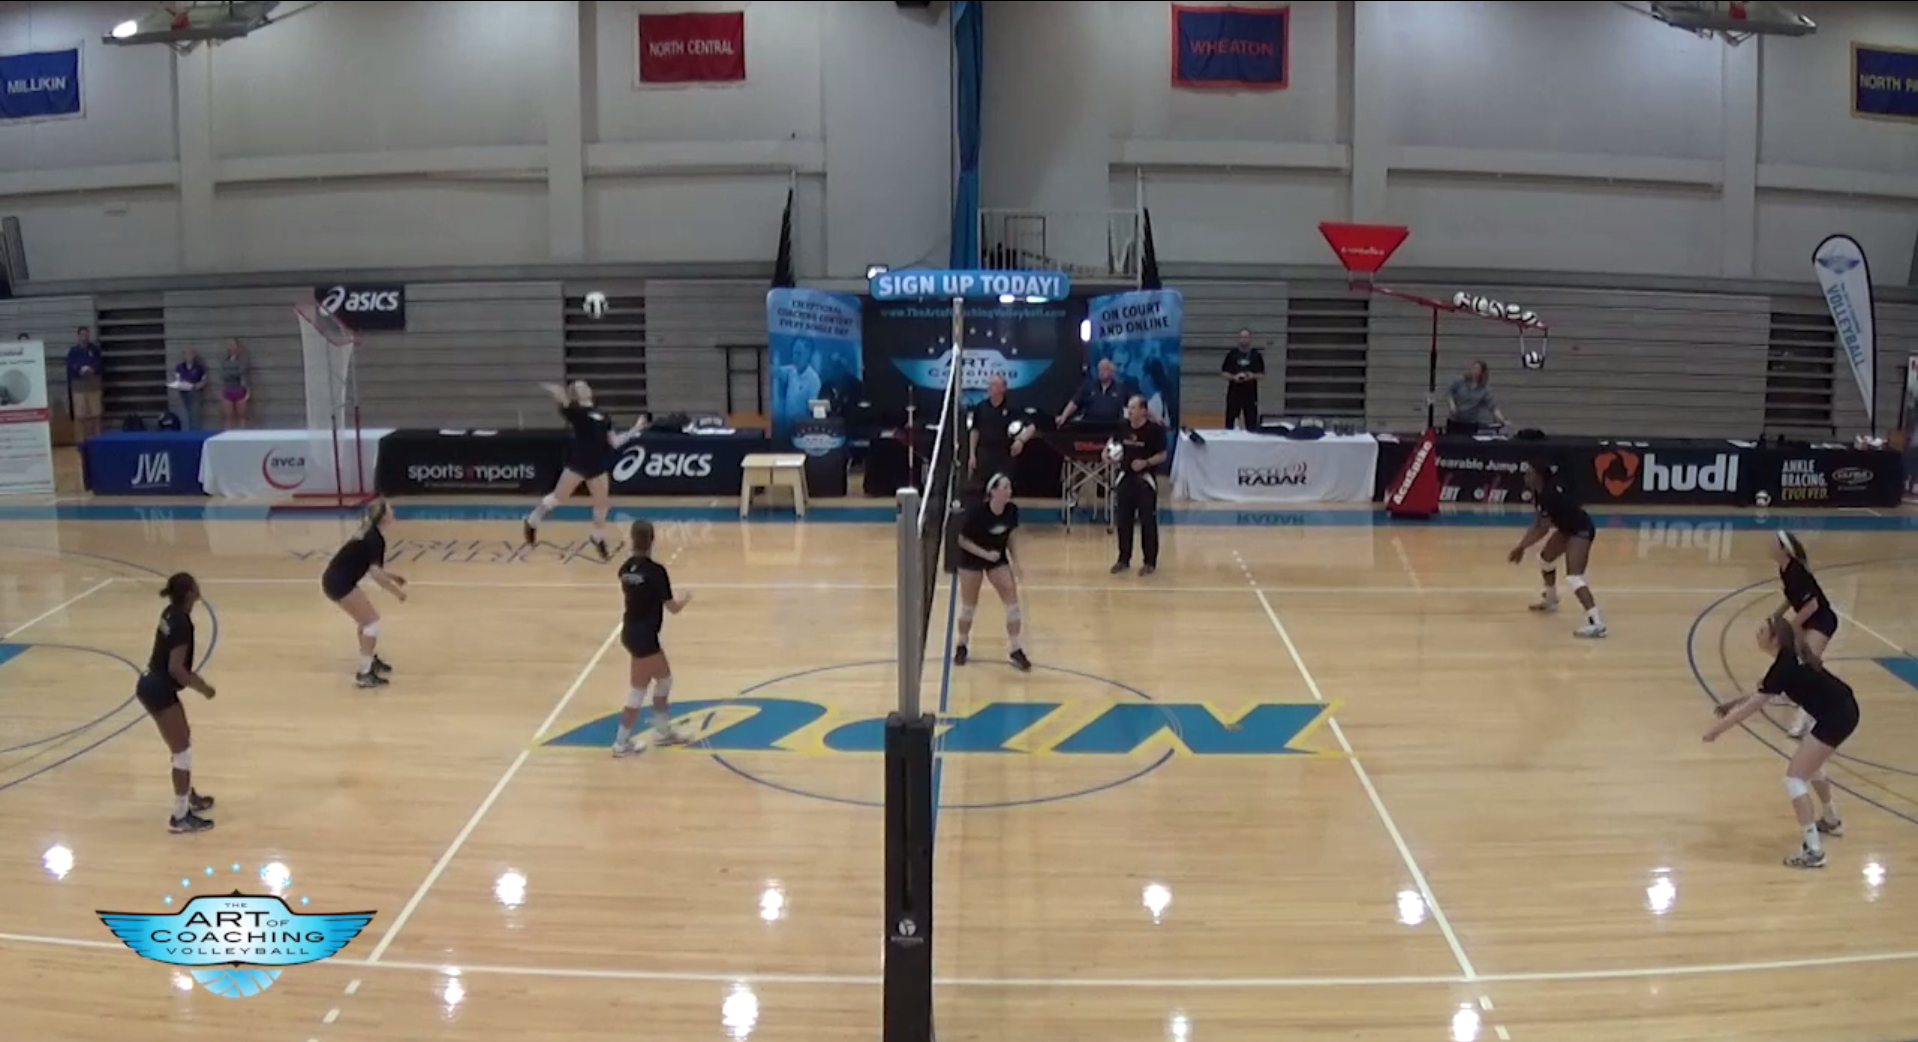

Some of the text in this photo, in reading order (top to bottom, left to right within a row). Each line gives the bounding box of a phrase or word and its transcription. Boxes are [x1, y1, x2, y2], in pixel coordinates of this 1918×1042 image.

[648, 39, 735, 57] NORTH CENTRAL
[1190, 39, 1273, 56] WHEATON
[7, 75, 67, 95] MILLIKIN
[1860, 74, 1901, 91] NORTH
[878, 274, 1061, 297] SIGN UP TODAY!
[344, 291, 400, 312] asics
[1102, 302, 1160, 322] ON COURT
[1100, 316, 1170, 338] AND ONLINE
[1826, 284, 1866, 367] VOLLEYBALL
[131, 452, 172, 485] JVA
[271, 455, 306, 467] avca
[644, 452, 713, 477] asics
[1485, 459, 1519, 474] Jump
[1782, 459, 1816, 473] ANKLE
[407, 463, 464, 482] sports
[1237, 474, 1307, 487] RADAR
[1642, 452, 1739, 492] hudl
[1781, 472, 1829, 487] BRACING.
